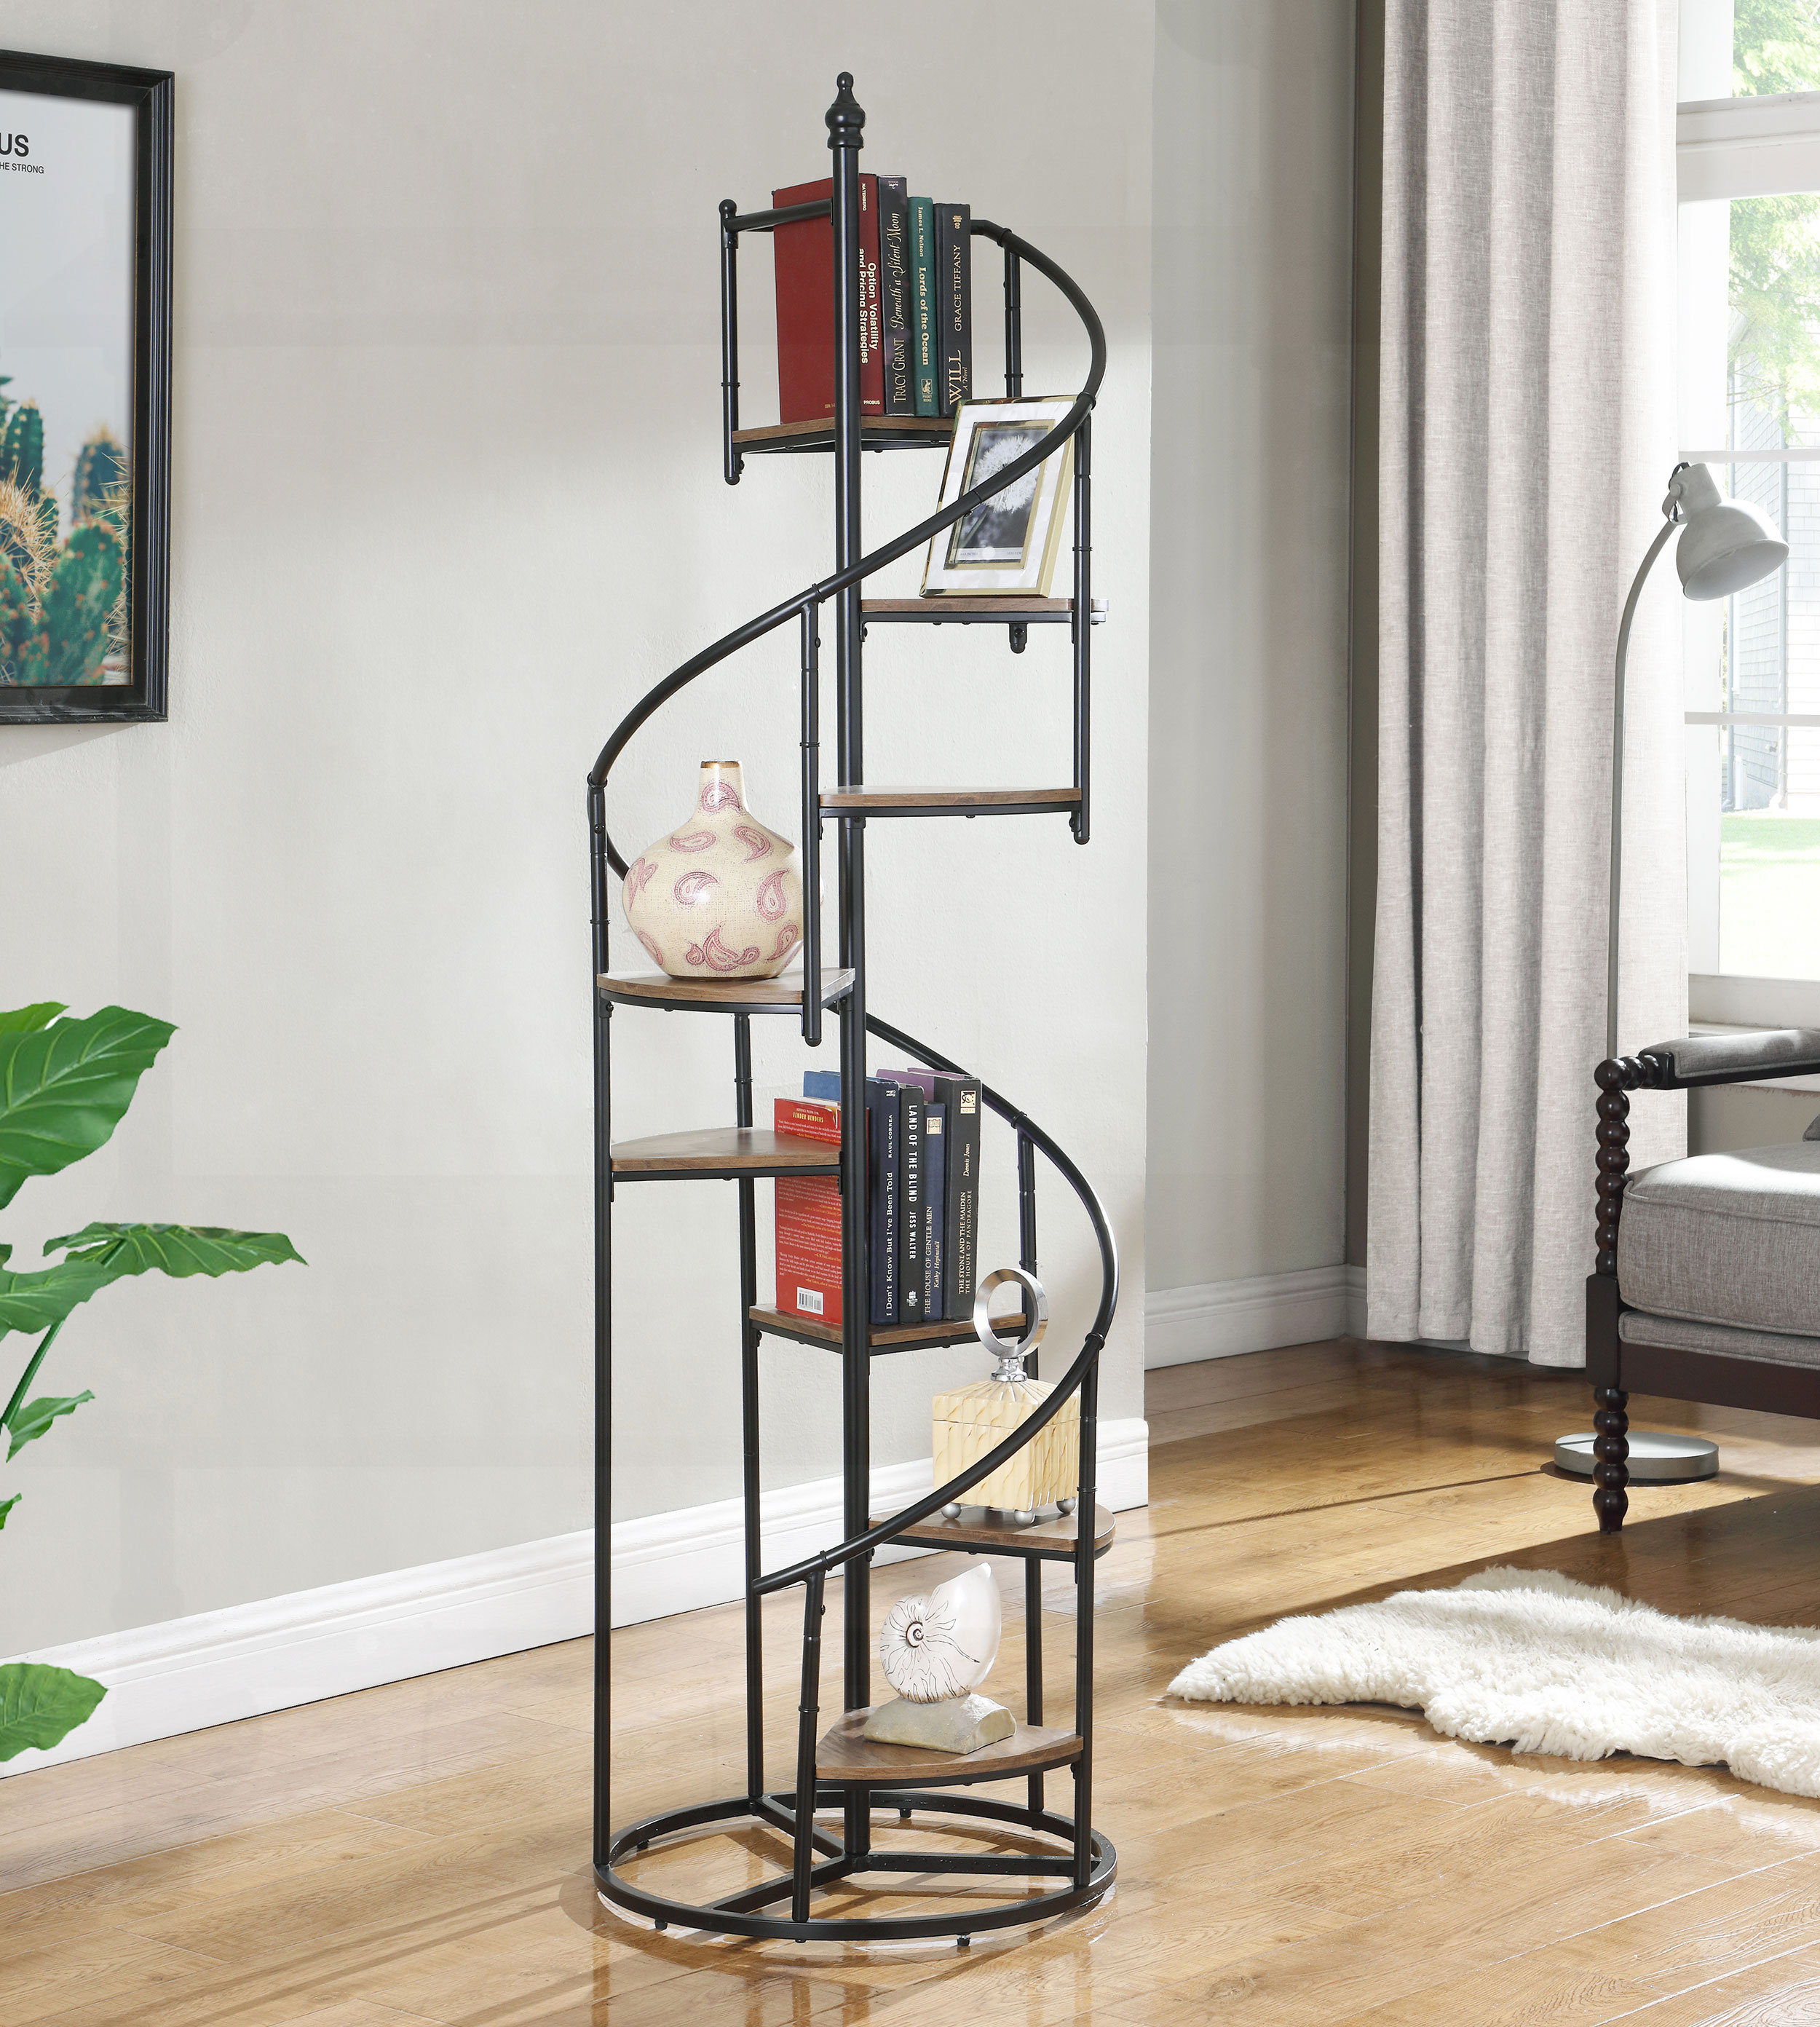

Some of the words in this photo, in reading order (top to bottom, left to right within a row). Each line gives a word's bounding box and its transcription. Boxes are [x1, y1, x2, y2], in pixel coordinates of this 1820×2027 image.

[0, 133, 29, 157] US
[12, 162, 44, 174] STRONG
[886, 213, 902, 242] Moon
[887, 242, 906, 277] Silent
[953, 245, 961, 291] TIFFANY
[866, 262, 877, 299] Option
[919, 266, 927, 297] Lords
[889, 285, 904, 330] Beneath
[919, 299, 928, 311] of
[954, 293, 962, 331] GRACE
[869, 303, 879, 350] Volatility
[920, 312, 929, 330] the
[859, 309, 870, 364] Strategies
[921, 332, 930, 366] Ocean
[892, 338, 906, 371] GRANT
[893, 373, 906, 403] TRACY
[948, 349, 962, 406] WILL
[908, 1105, 918, 1131] LAND
[908, 1134, 918, 1146] OF
[908, 1151, 918, 1169] THE
[908, 1174, 917, 1202] BLIND
[909, 1211, 917, 1228] JESS
[909, 1230, 917, 1260] WALTER
[966, 1241, 971, 1250] OF
[925, 1257, 932, 1268] OF
